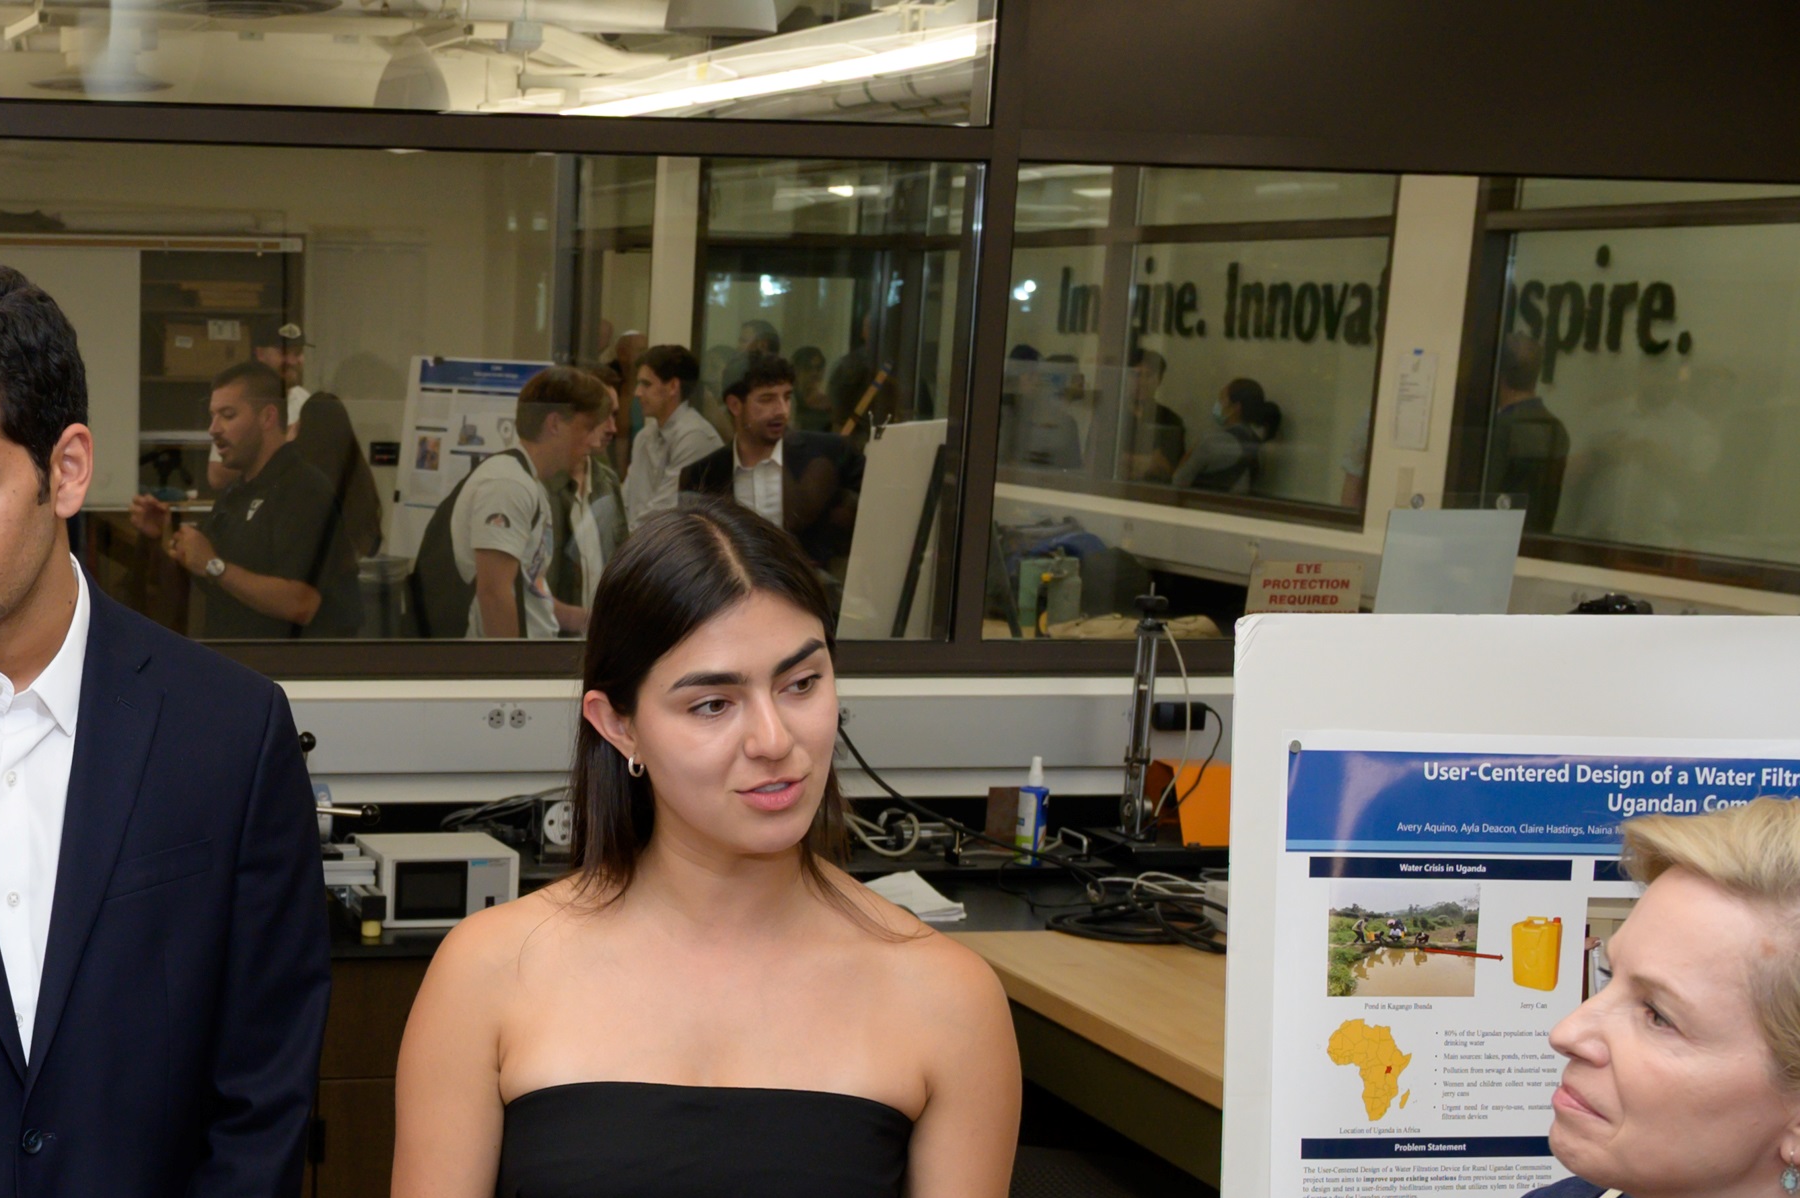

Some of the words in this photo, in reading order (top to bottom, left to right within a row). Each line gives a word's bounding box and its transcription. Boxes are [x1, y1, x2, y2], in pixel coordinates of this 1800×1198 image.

[1057, 257, 1206, 346] Imine.
[1506, 244, 1693, 385] spire.
[1295, 563, 1322, 574] EYE
[1262, 579, 1350, 590] PROTECTION
[1268, 594, 1339, 606] REQUIRED
[1423, 760, 1570, 783] User-Centered
[1576, 764, 1645, 789] Design
[1650, 764, 1673, 784] of
[1677, 770, 1689, 785] a
[1694, 766, 1756, 786] Water
[1607, 792, 1698, 819] Ugandan
[1396, 821, 1423, 834] Avery
[1423, 822, 1458, 834] Aquino,
[1460, 822, 1480, 835] Ayla
[1481, 822, 1517, 834] Deacon,
[1519, 823, 1544, 834] Claire
[1546, 824, 1585, 837] Hastings,
[1587, 824, 1612, 835] Naina
[1399, 863, 1423, 872] Water
[1423, 863, 1445, 872] Crisis
[1445, 863, 1454, 872] in
[1455, 863, 1487, 874] Uganda
[1394, 1142, 1426, 1152] Problem
[1427, 1142, 1466, 1151] Statement
